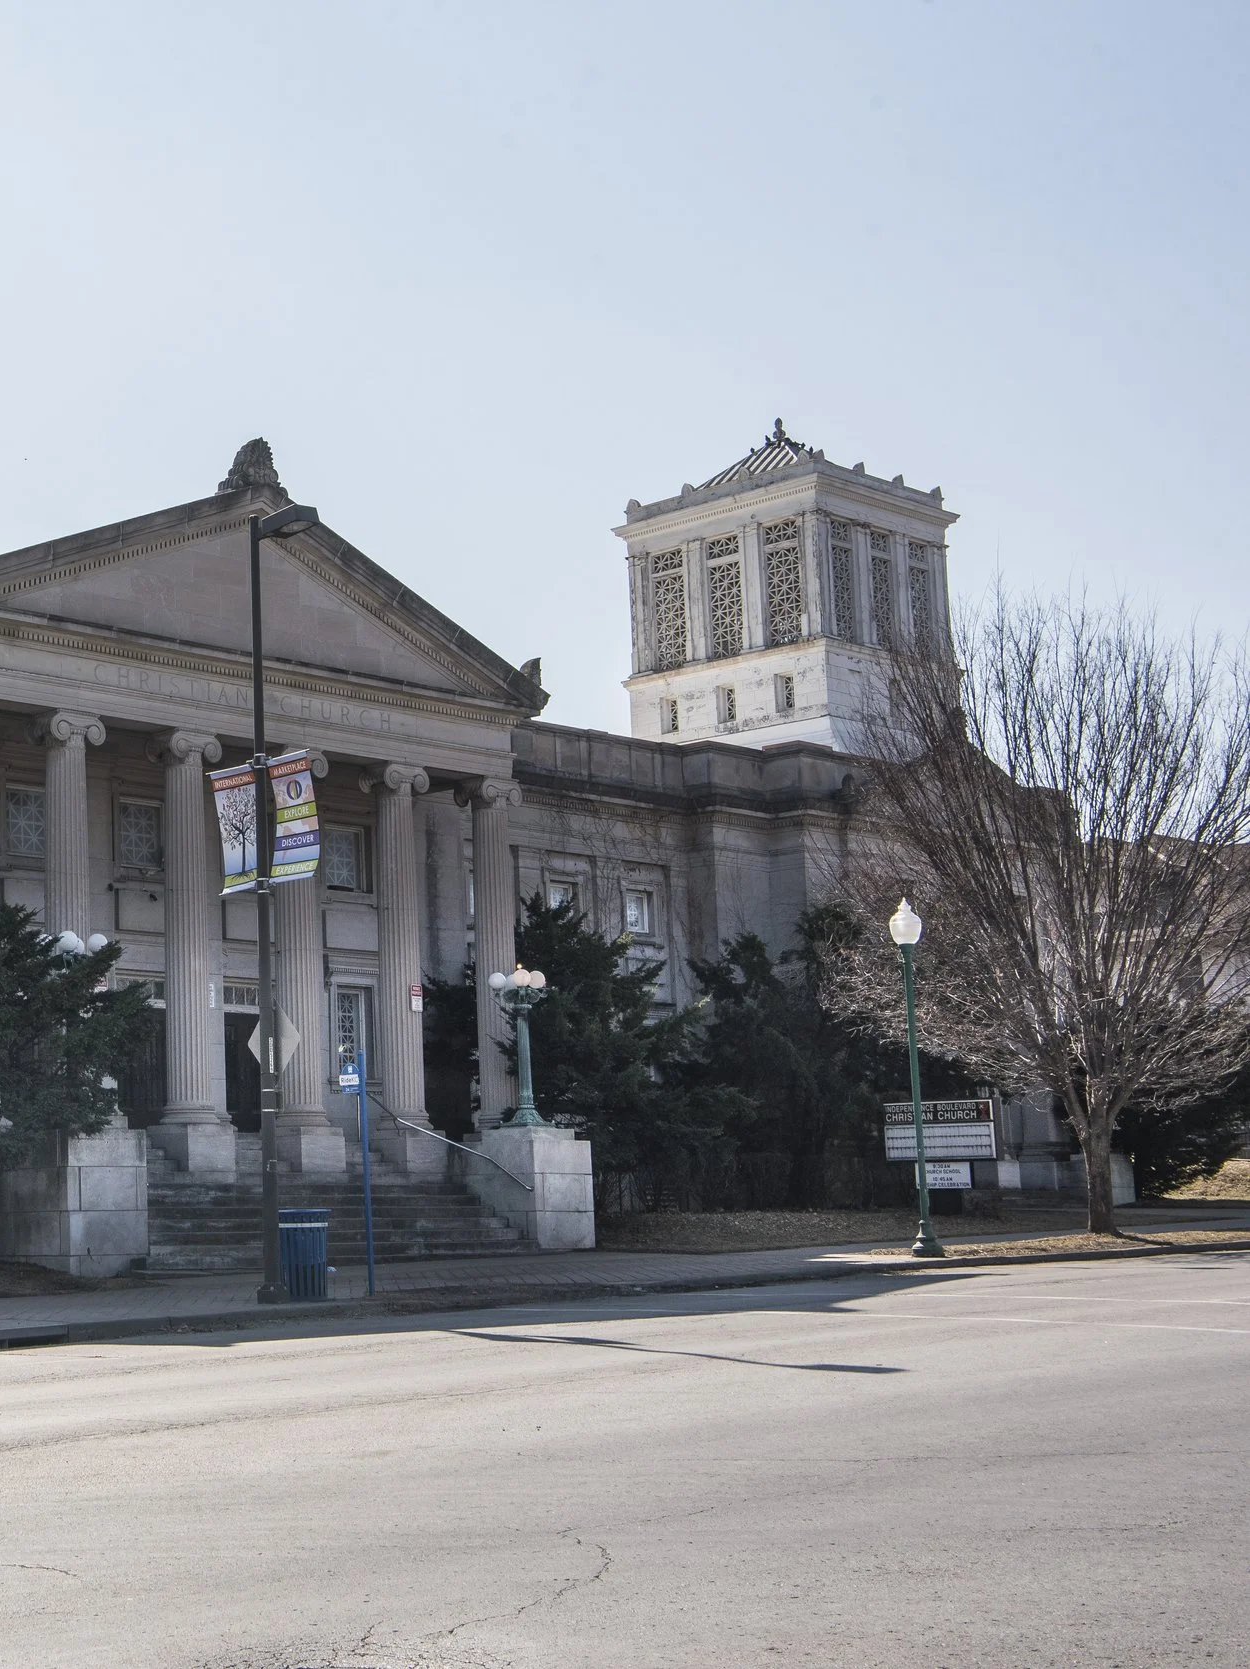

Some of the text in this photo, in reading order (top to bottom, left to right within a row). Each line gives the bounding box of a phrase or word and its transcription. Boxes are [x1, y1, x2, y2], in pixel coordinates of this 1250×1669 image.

[93, 663, 392, 730] CHRISTIAN CHURCH
[273, 760, 307, 776] MARKETPLACE
[214, 774, 253, 789] INTERNATIONAL
[284, 805, 309, 819] EXPLORE
[281, 834, 315, 847] DISCOVER
[276, 862, 314, 875] EXPERIENCE
[885, 1102, 976, 1112] INDEPENNCE BOULEVARD
[885, 1110, 976, 1122] CHRISAN CHURCH
